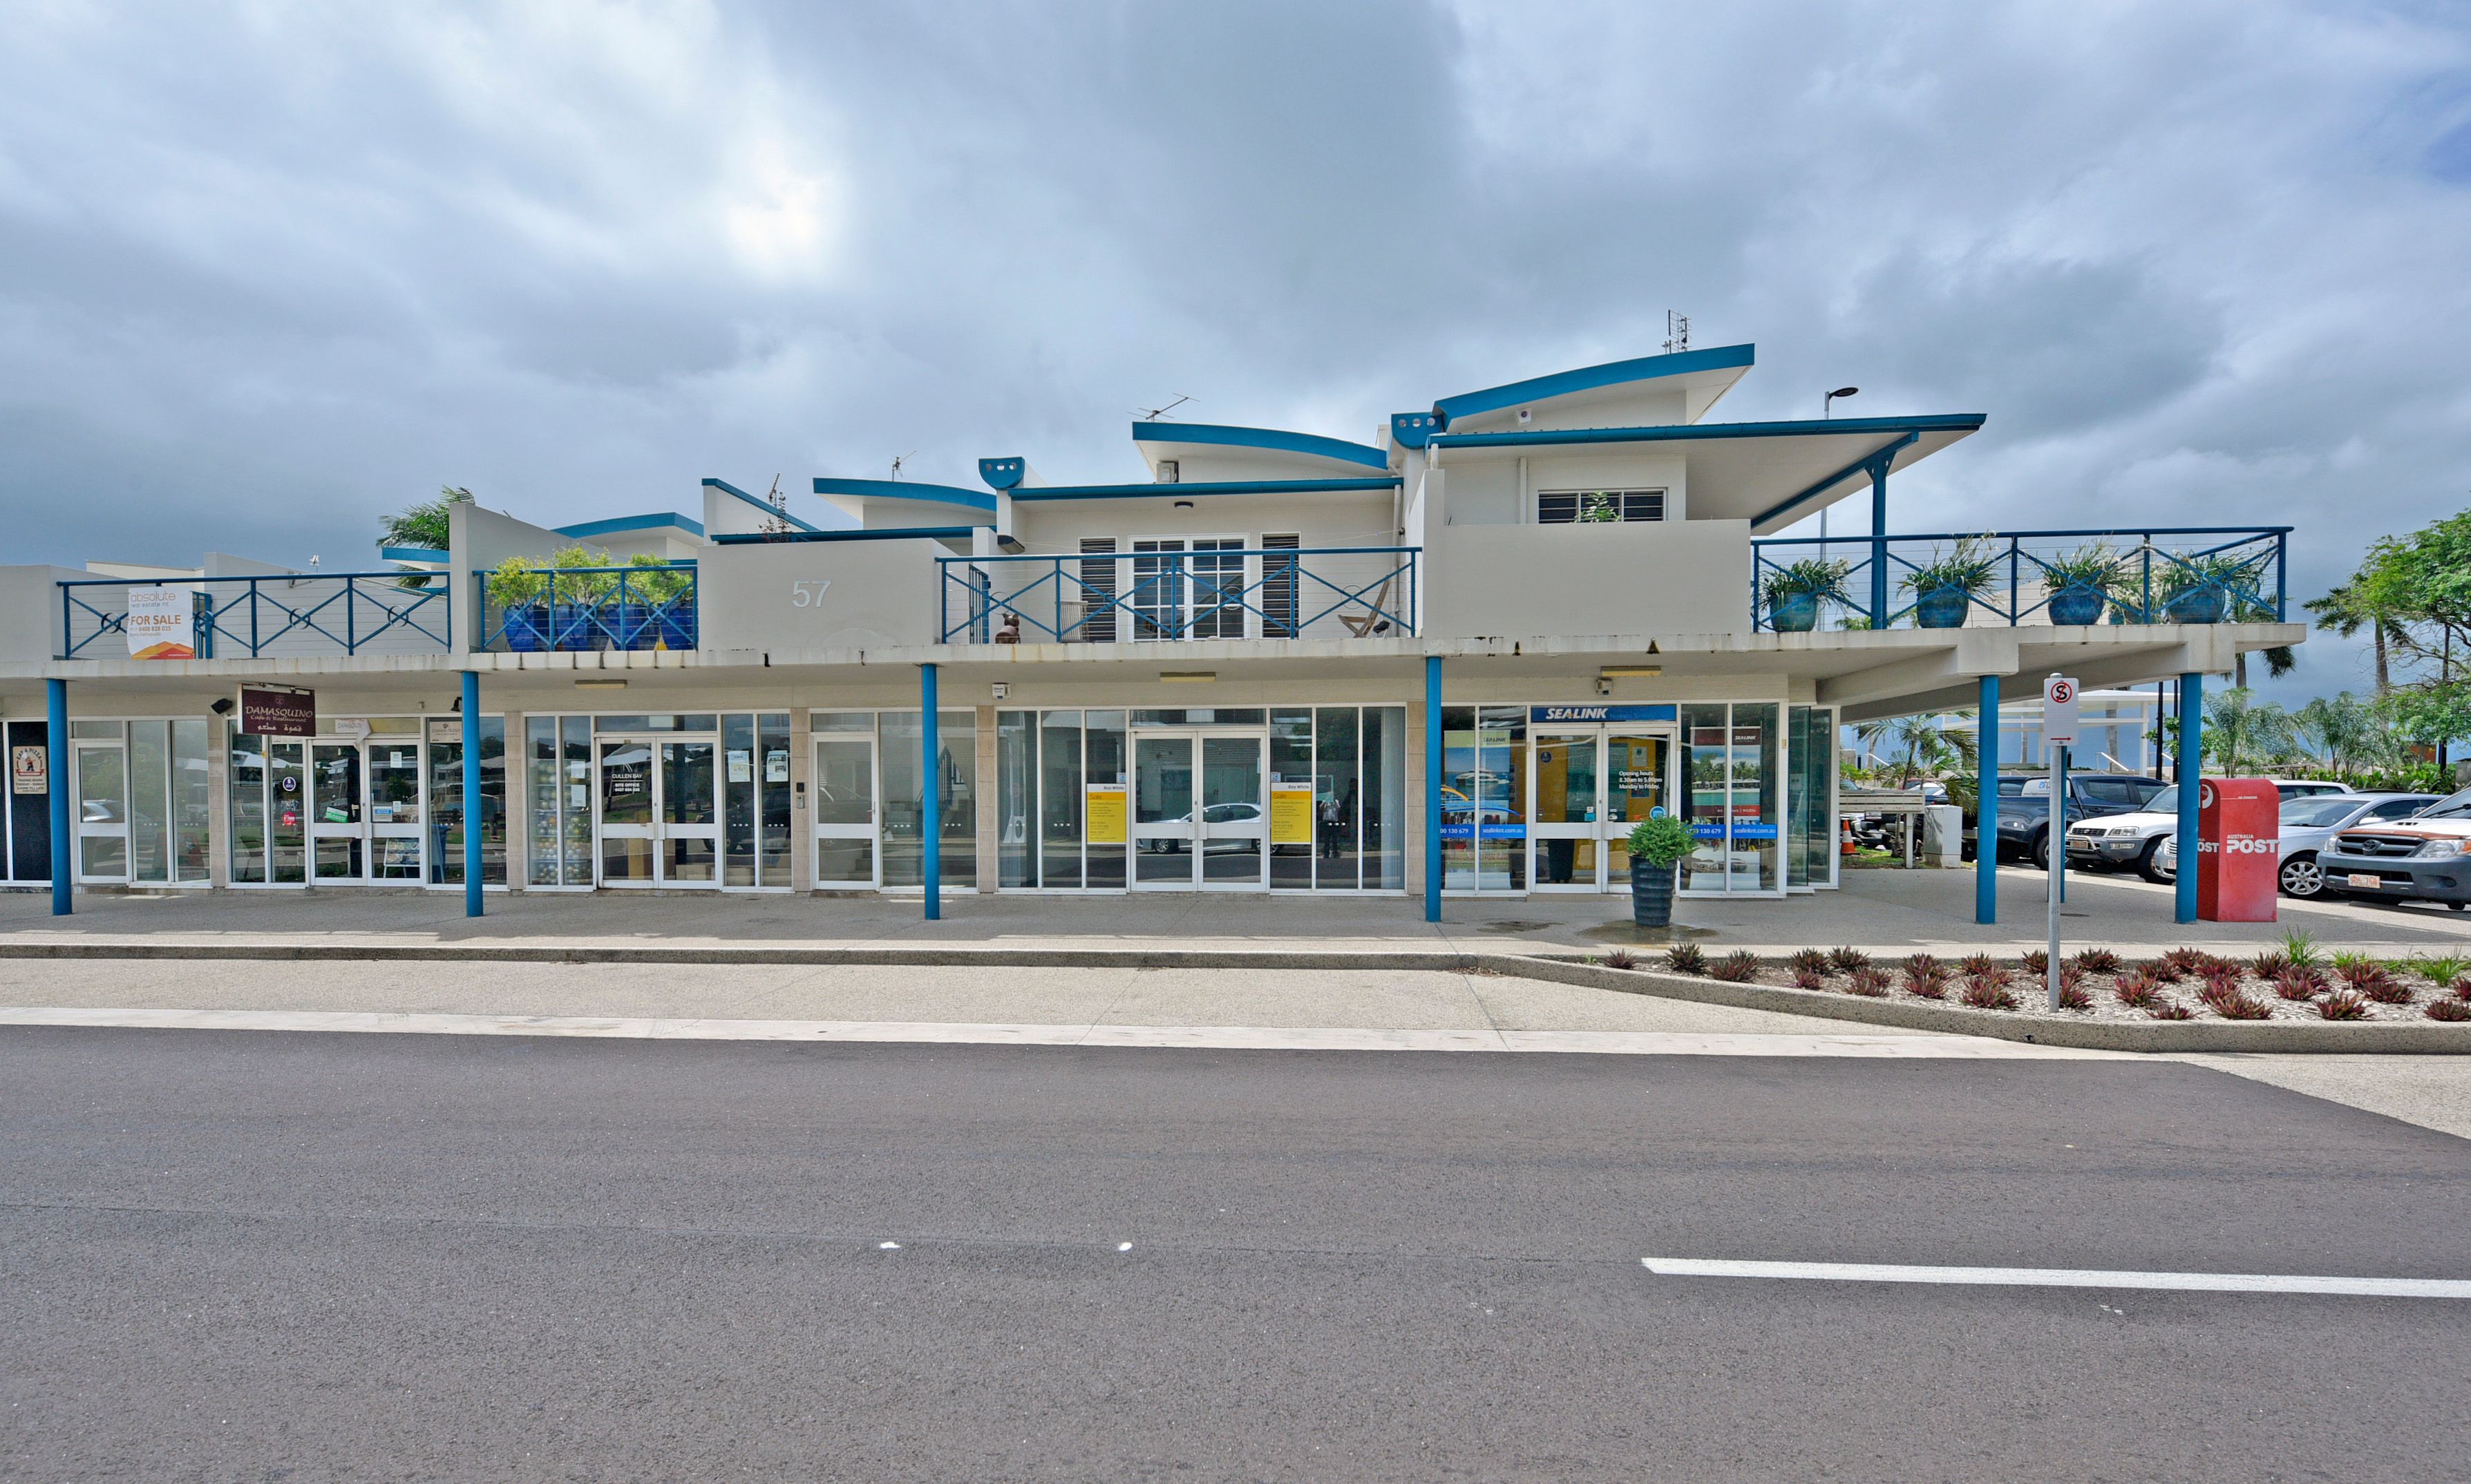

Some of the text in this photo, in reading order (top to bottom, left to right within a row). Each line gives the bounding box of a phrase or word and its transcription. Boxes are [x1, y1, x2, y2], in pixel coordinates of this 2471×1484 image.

[131, 591, 176, 602] absolute
[792, 580, 831, 608] 57
[131, 615, 182, 625] FOR SALE
[245, 706, 313, 718] DAMASQUINO
[1546, 708, 1609, 720] SEALINK
[2198, 841, 2219, 853] OST
[2226, 839, 2279, 854] POST
